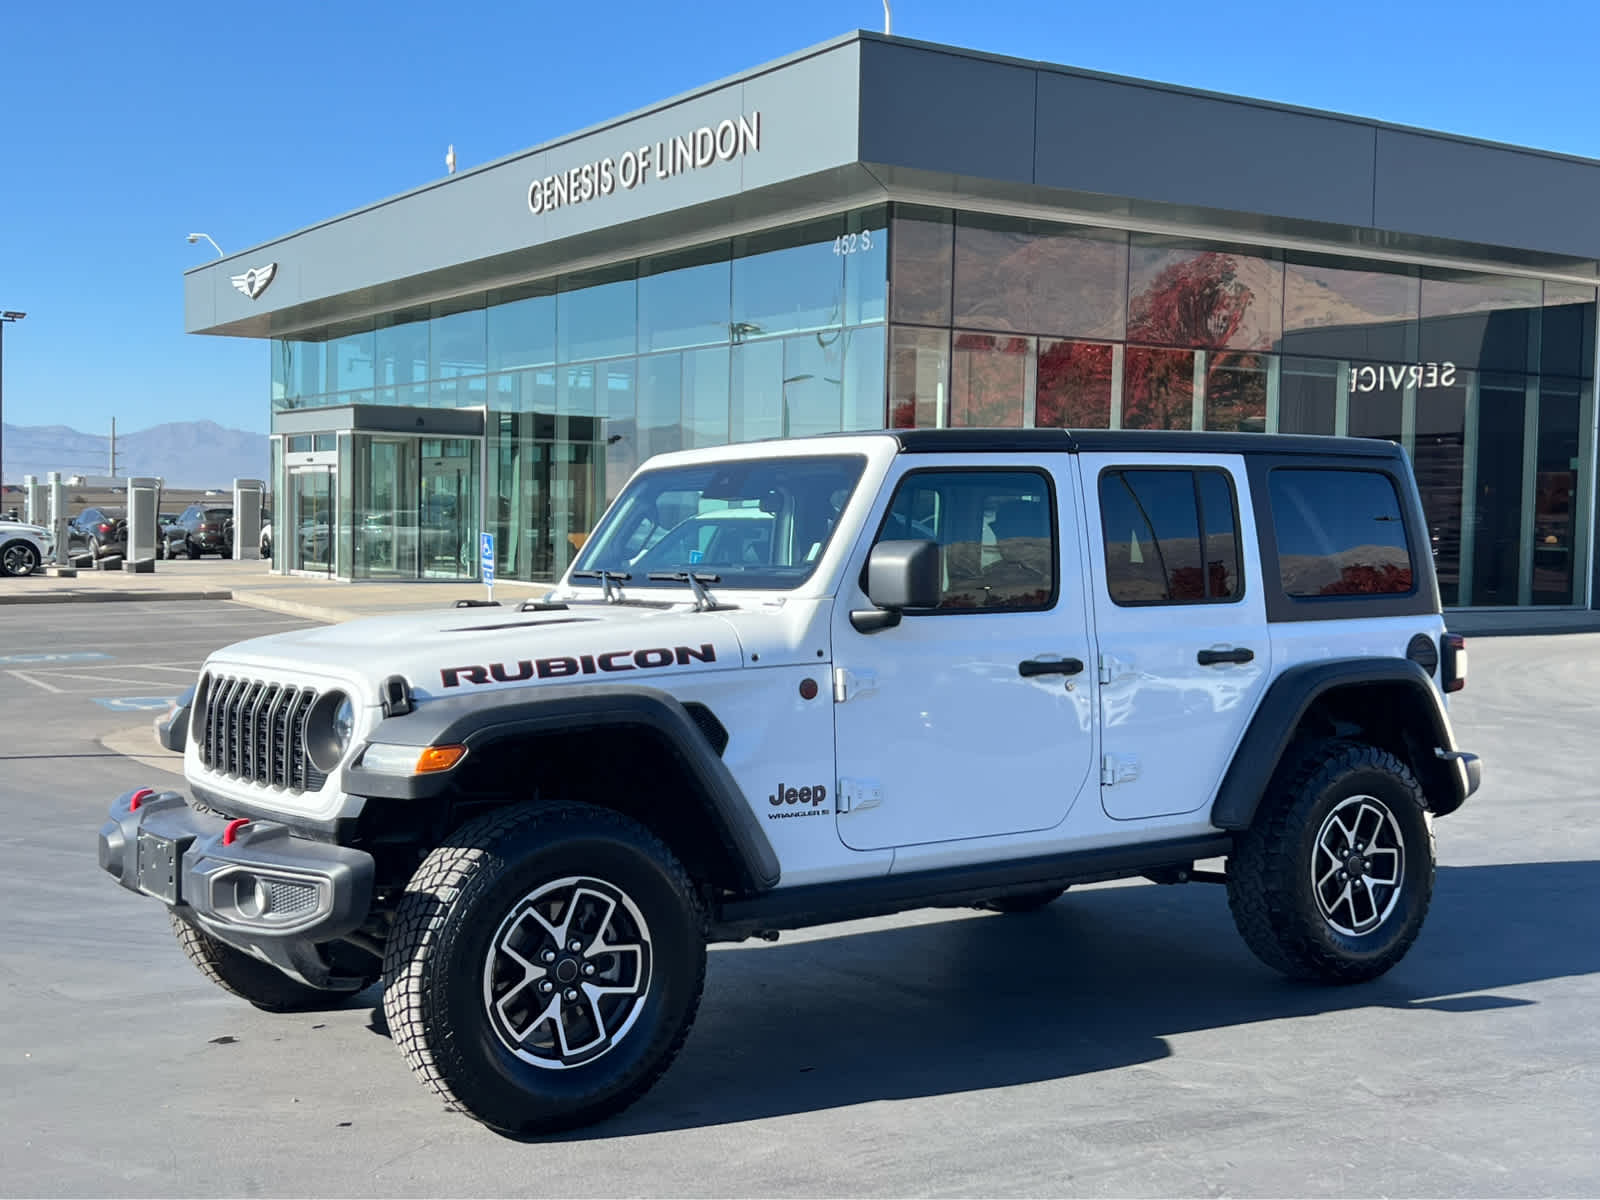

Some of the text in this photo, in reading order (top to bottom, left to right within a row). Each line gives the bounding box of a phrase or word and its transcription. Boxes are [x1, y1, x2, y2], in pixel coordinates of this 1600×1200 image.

[528, 111, 761, 215] GENESIS OF LINDON
[440, 643, 717, 688] RUBICON
[769, 783, 826, 807] Jeep
